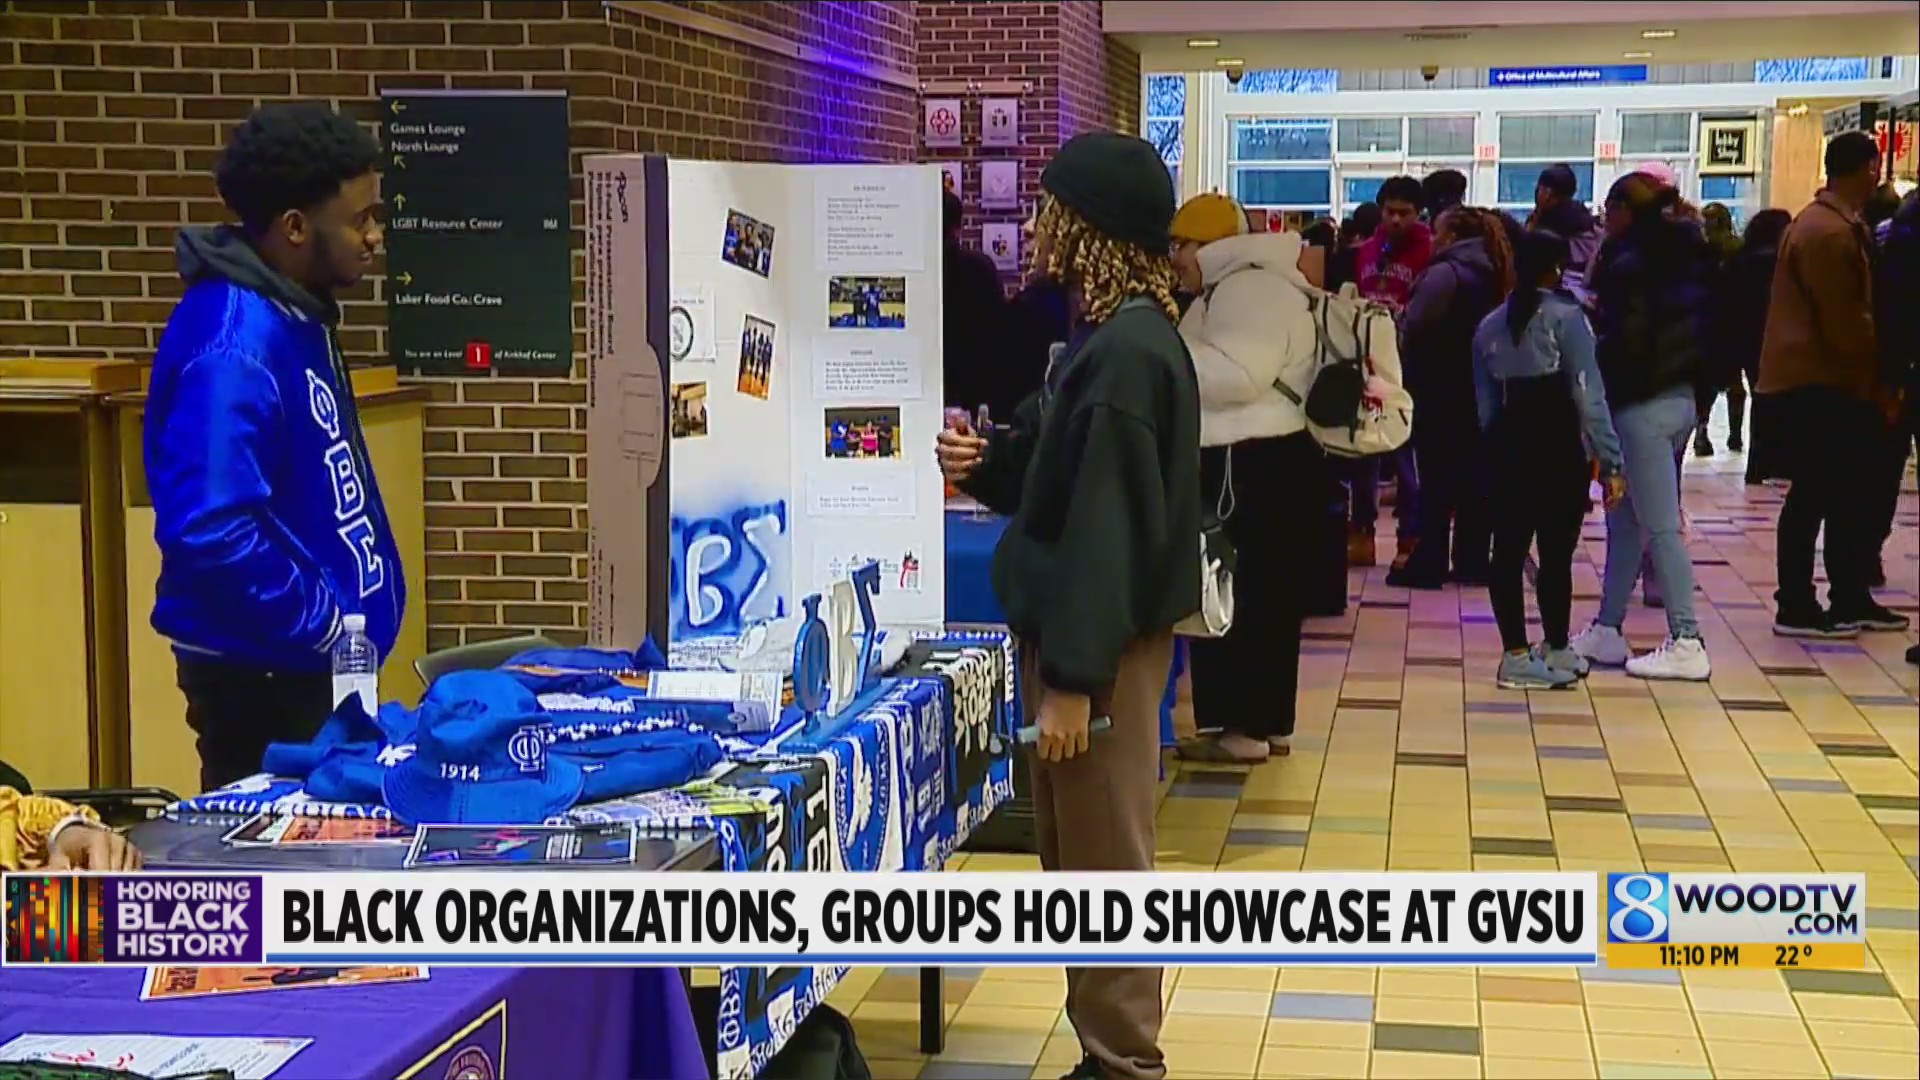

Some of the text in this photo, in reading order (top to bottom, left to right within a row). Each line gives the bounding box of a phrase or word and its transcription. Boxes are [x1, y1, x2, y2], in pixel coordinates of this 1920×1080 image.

[390, 122, 466, 136] Games Lounge
[391, 140, 459, 155] North Lounge
[392, 217, 504, 230] LGBT Resource Center
[396, 293, 422, 305] Laker
[424, 293, 450, 305] Food
[473, 293, 503, 306] Crave
[440, 762, 480, 783] 1914
